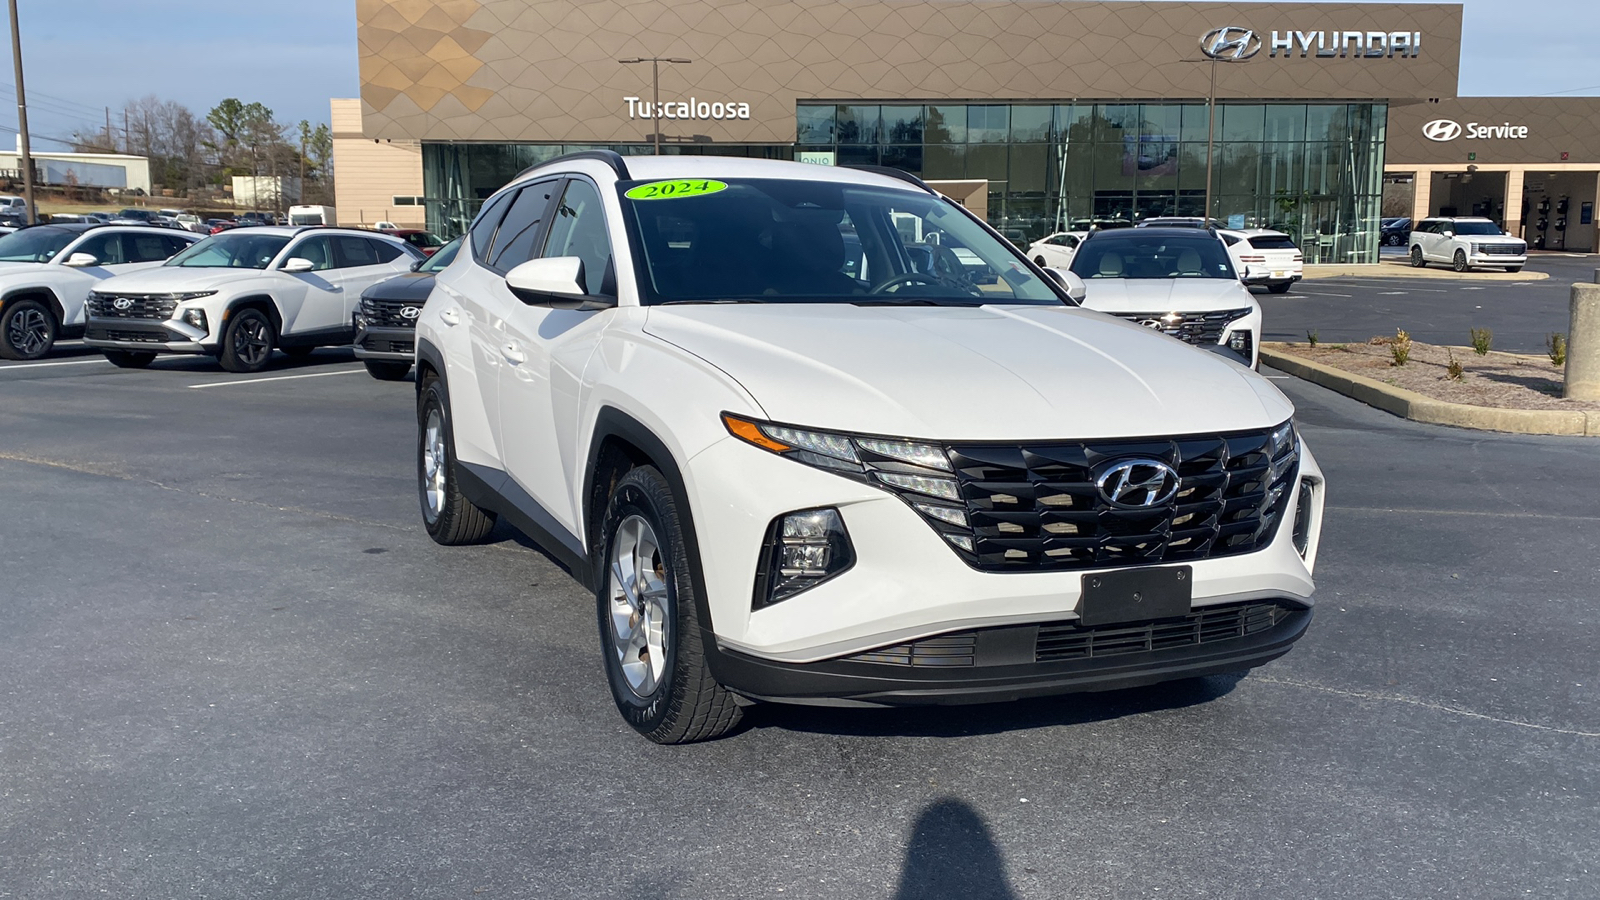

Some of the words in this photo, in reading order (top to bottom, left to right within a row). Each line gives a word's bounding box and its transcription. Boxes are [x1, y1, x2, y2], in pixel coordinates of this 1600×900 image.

[1269, 30, 1421, 58] HYUNDAI
[623, 96, 750, 119] Tuscaloosa
[1466, 122, 1528, 139] Service
[644, 180, 709, 198] 2024
